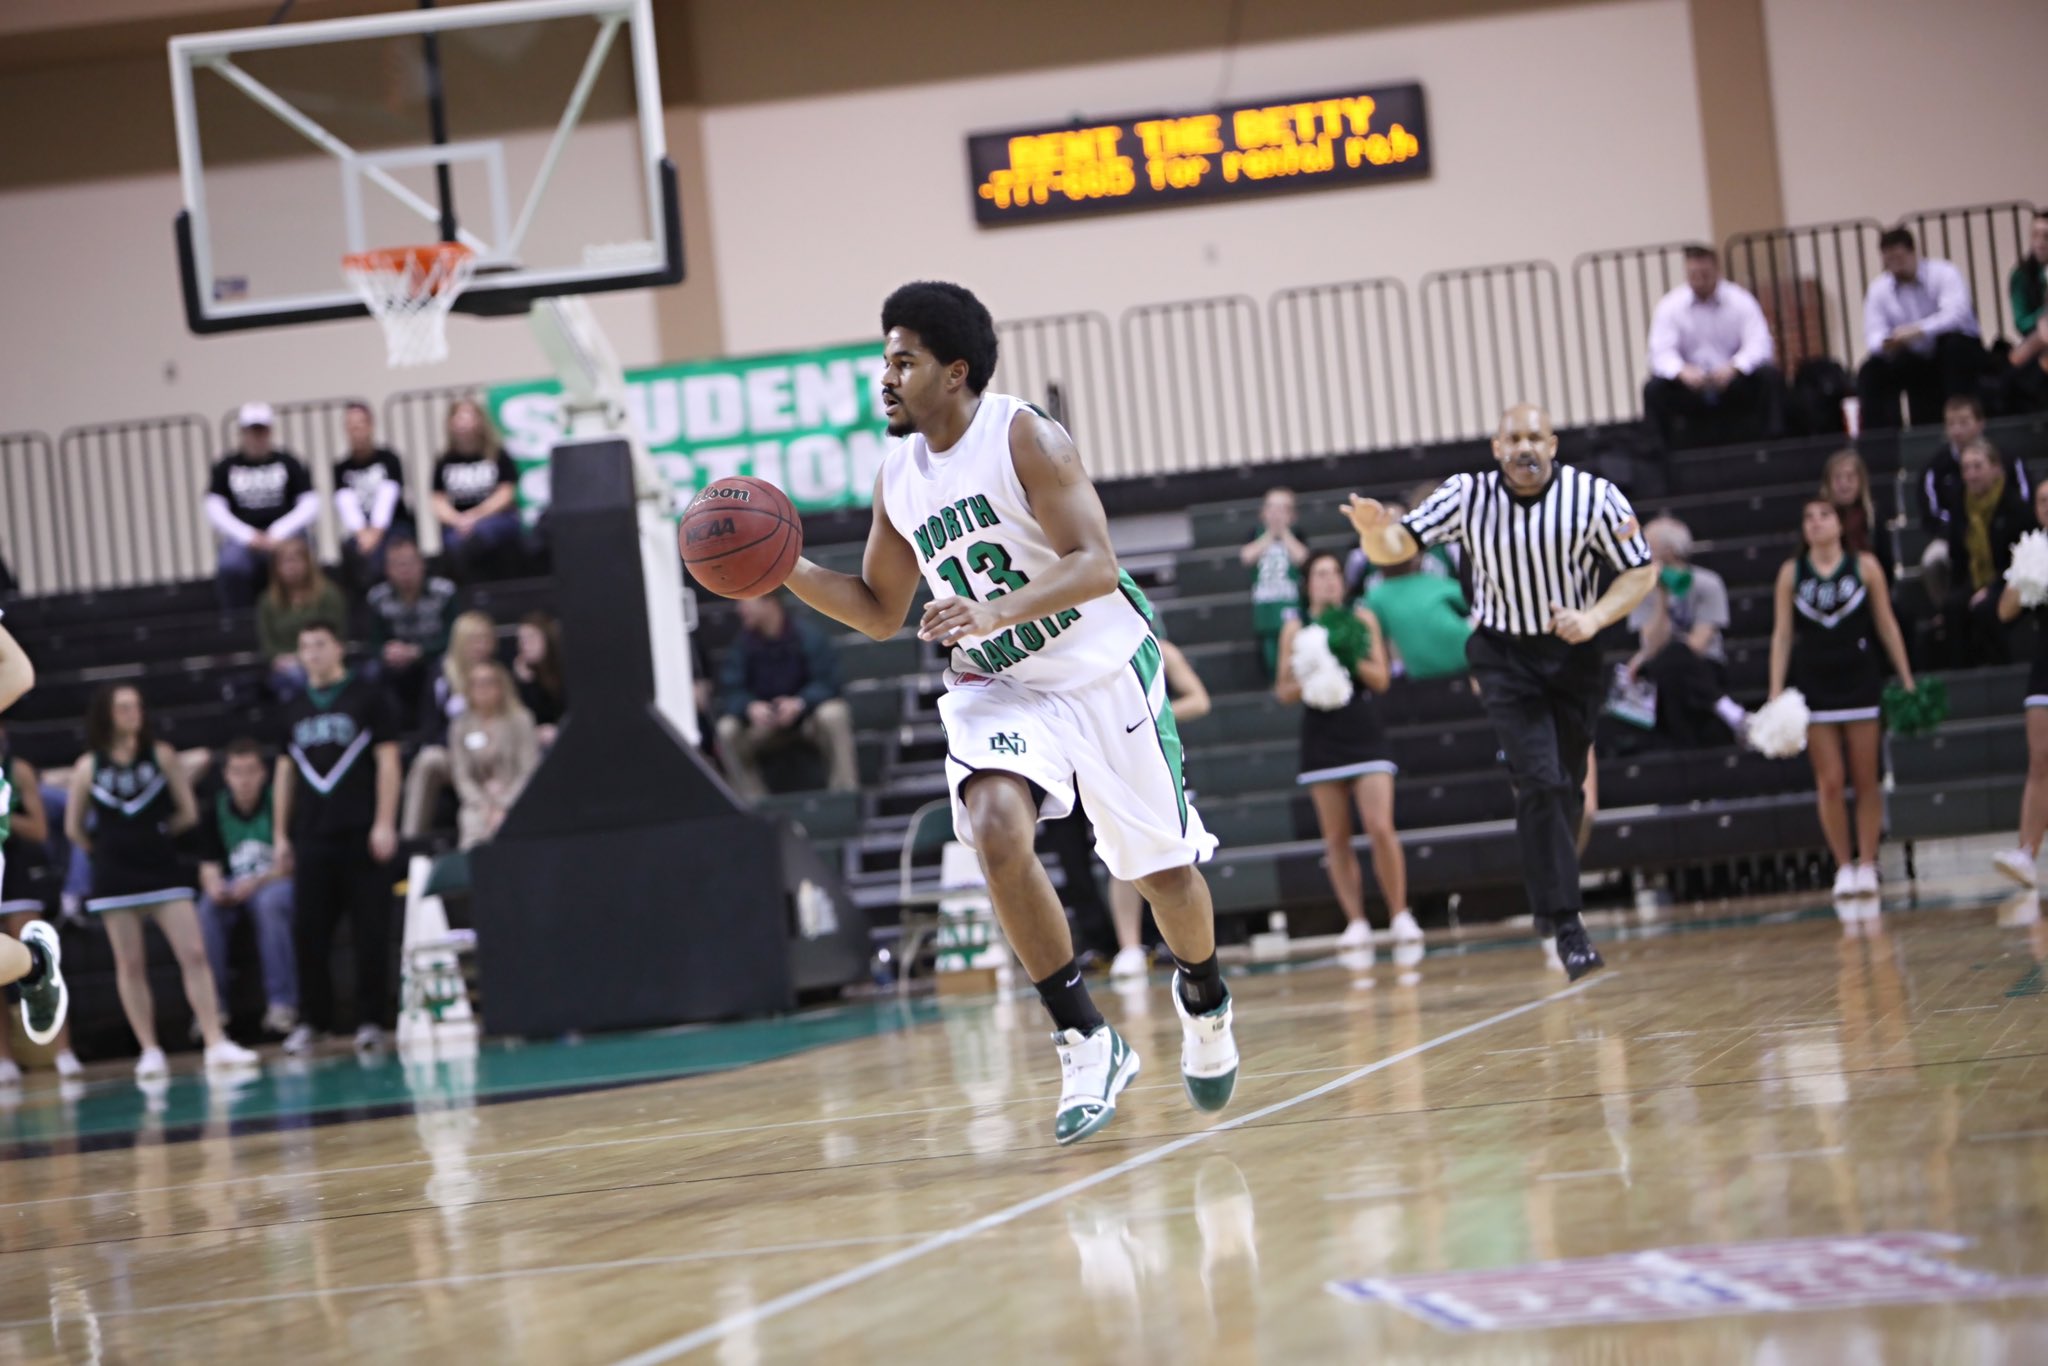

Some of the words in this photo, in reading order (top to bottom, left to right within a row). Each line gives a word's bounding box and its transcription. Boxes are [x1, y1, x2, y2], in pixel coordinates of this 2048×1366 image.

[1134, 114, 1223, 158] THE
[1233, 95, 1375, 149] BETTY
[499, 356, 887, 462] SUDENT
[913, 494, 1001, 563] NORTH
[937, 540, 1030, 602] 13
